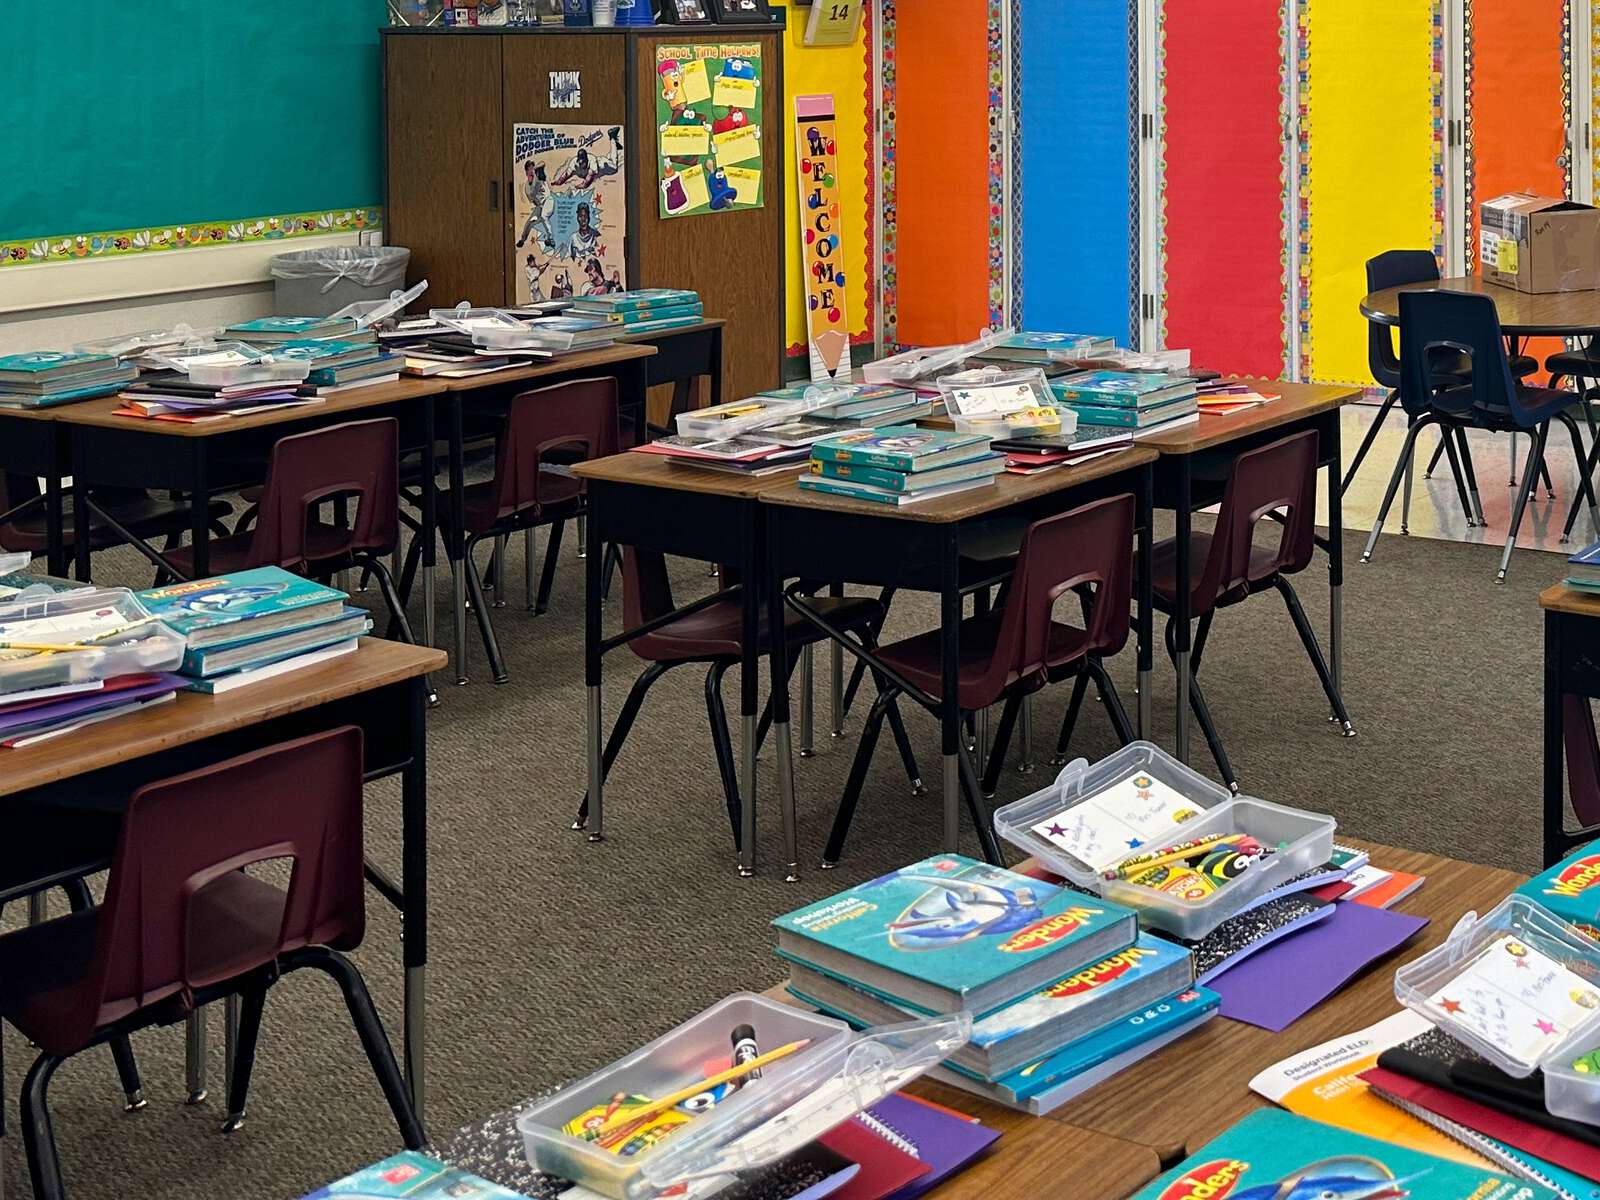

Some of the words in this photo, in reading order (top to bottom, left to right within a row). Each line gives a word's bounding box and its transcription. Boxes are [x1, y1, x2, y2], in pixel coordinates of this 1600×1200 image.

[829, 4, 849, 21] 14
[549, 71, 581, 90] THINK
[550, 90, 581, 108] BLUE
[516, 134, 555, 144] ADVENTURES
[516, 140, 550, 156] DODGER
[554, 138, 574, 146] BLUE
[807, 136, 836, 310] WELCOME
[141, 579, 231, 599] Wonders
[998, 906, 1104, 954] Wonders
[1042, 947, 1158, 999] Wonders
[1284, 1045, 1347, 1077] Designated
[1347, 1040, 1370, 1052] ELD
